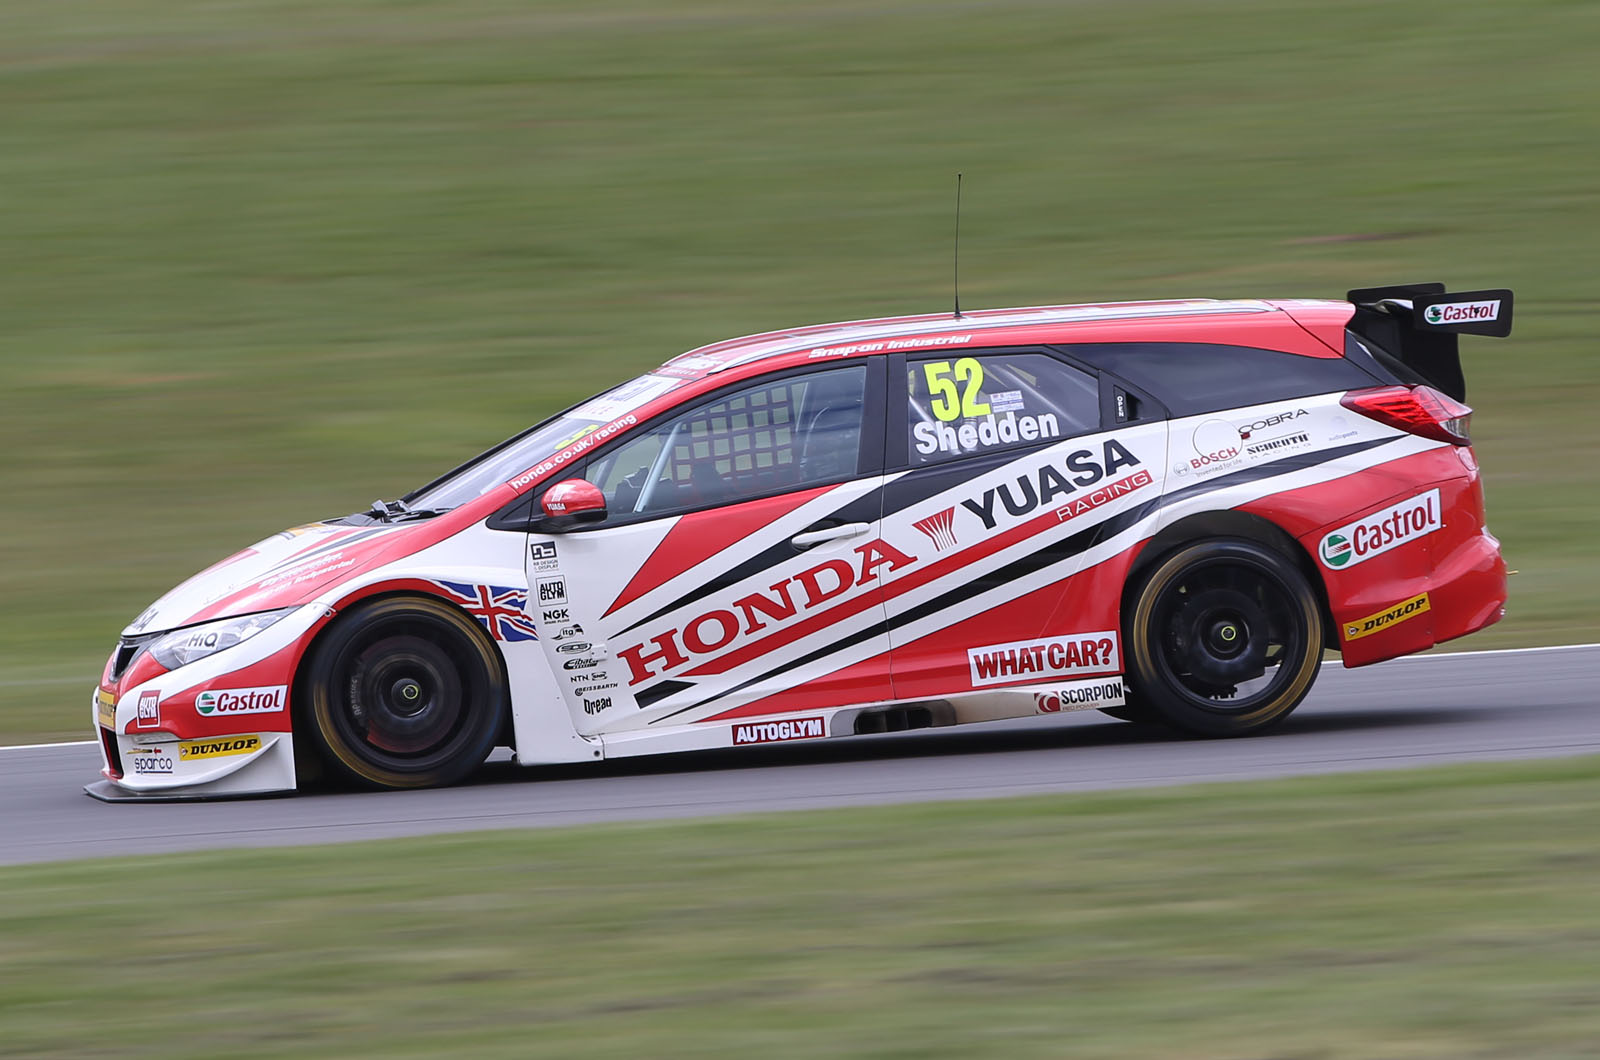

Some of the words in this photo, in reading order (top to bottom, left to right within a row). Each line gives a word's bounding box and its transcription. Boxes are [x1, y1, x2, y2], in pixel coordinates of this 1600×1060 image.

[1443, 303, 1495, 321] Castrol
[808, 343, 884, 359] Snap-on
[887, 334, 973, 350] Industrial
[923, 357, 991, 422] 52
[913, 412, 1060, 454] Shedden
[1238, 408, 1310, 434] COBRA
[511, 414, 638, 489] honda.co.uk/racing
[1190, 446, 1239, 470] BOSCH
[960, 438, 1141, 530] YUASA
[1055, 472, 1149, 522] RACING
[1353, 497, 1436, 556] Castrol
[540, 581, 564, 592] AUTO
[540, 590, 565, 601] GLYM
[543, 608, 569, 621] NGK
[617, 538, 918, 687] HONDA
[1362, 597, 1427, 632] DUNLOP
[187, 632, 219, 648] HiQ
[973, 644, 1045, 680] WHAT
[1047, 638, 1114, 670] CAR?
[570, 674, 589, 683] NTN
[216, 689, 281, 713] Castrol
[583, 696, 612, 715] Dread
[1060, 682, 1123, 705] SCORPION
[736, 719, 823, 744] AUTOGLYM
[190, 737, 258, 756] DUNLOP
[134, 757, 173, 775] sparco
